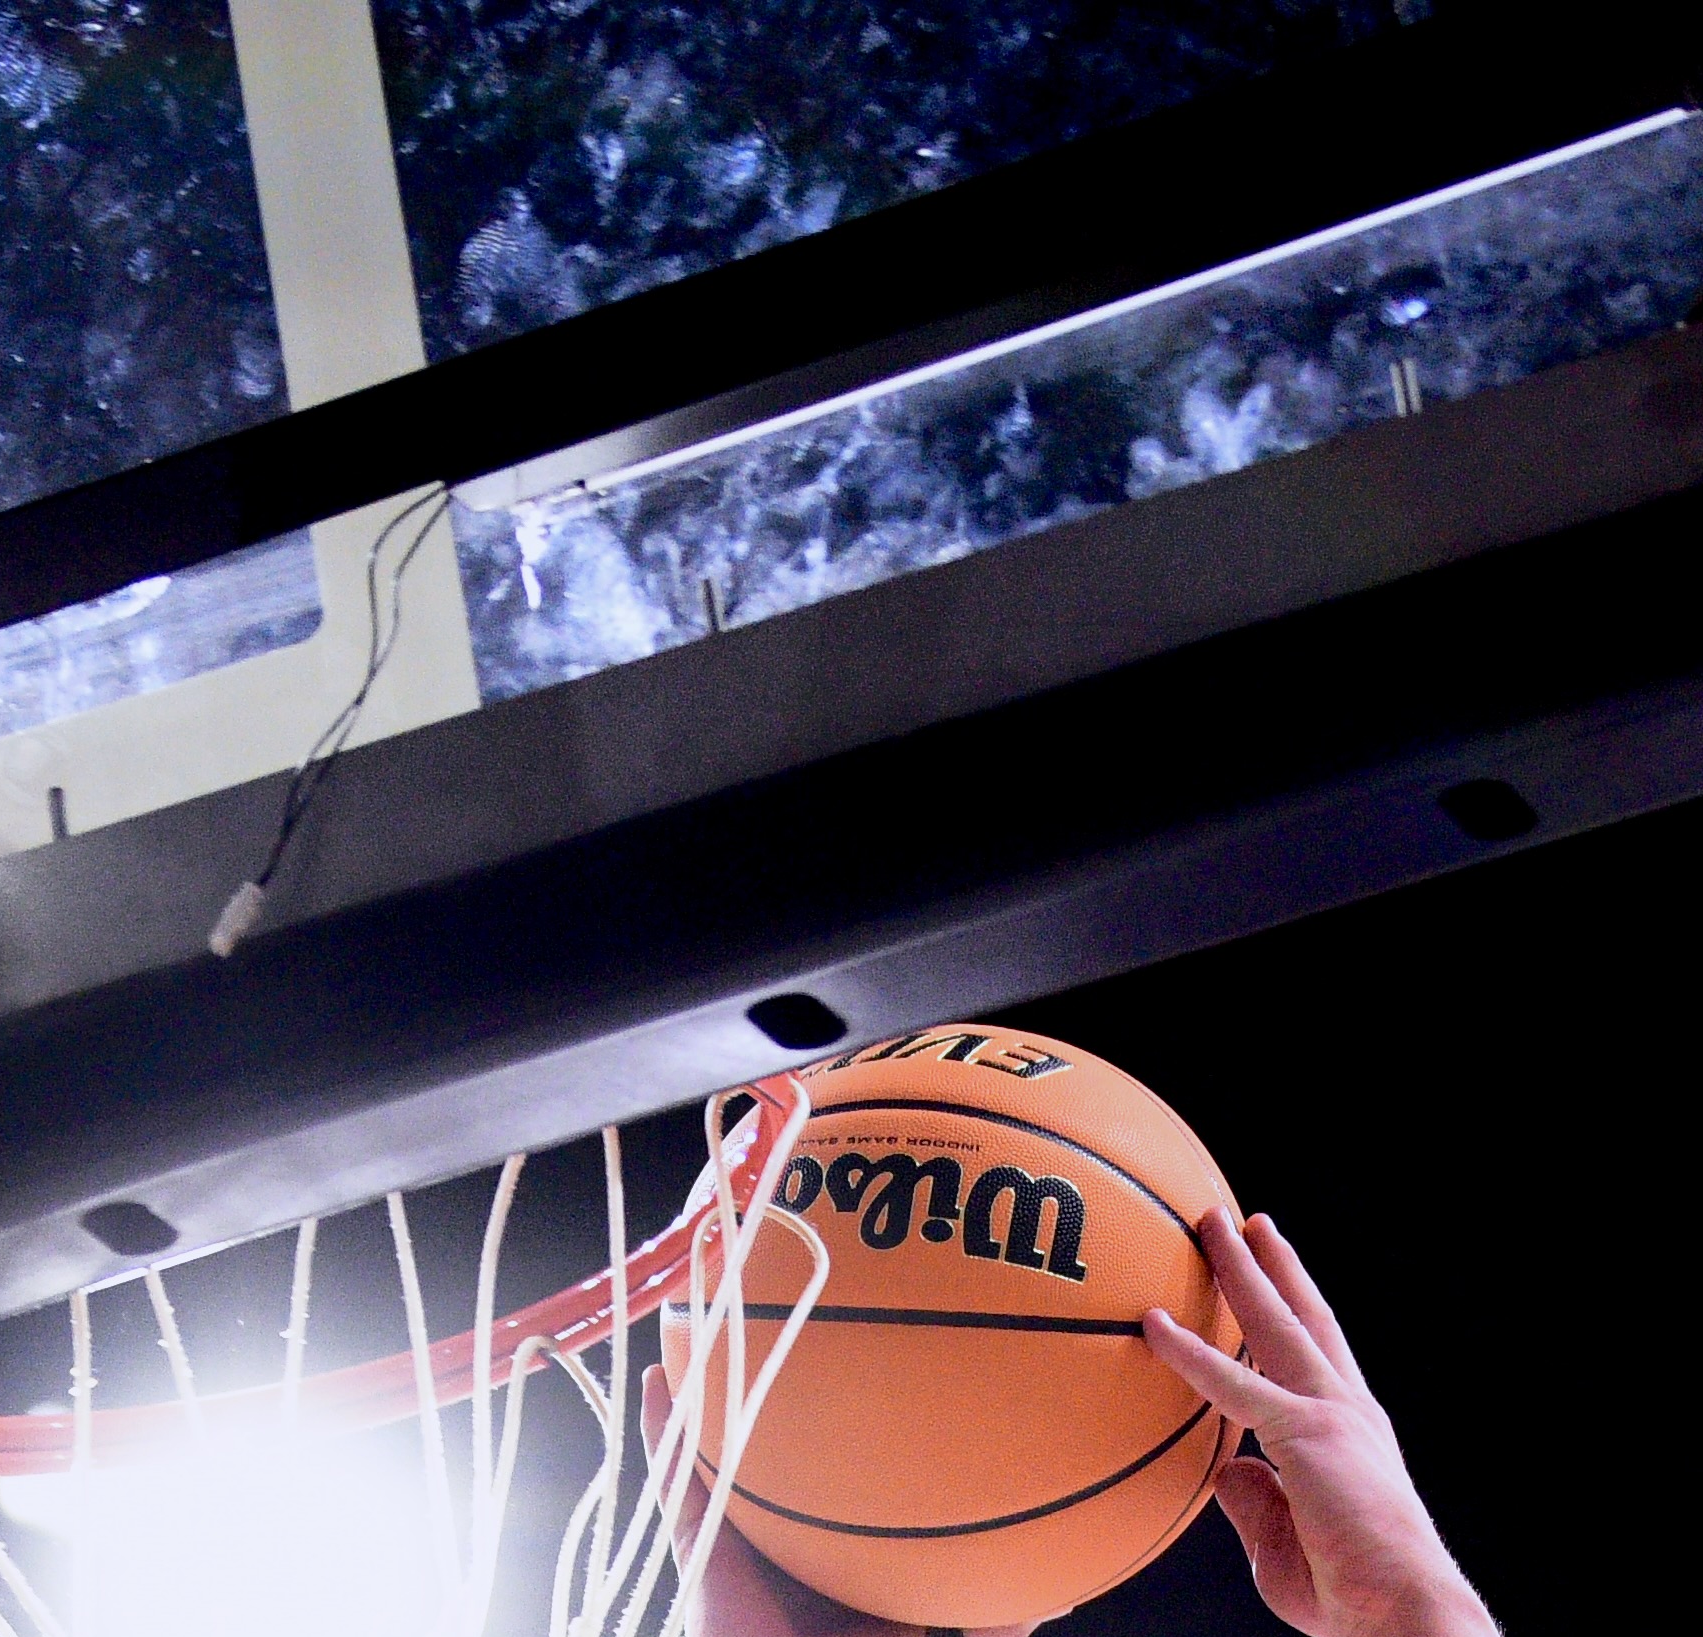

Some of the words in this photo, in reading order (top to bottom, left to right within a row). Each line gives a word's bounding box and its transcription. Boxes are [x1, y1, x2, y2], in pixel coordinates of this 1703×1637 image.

[846, 1134, 899, 1146] GAME
[906, 1137, 983, 1152] INDOOR
[747, 1153, 1088, 1285] Wilso
